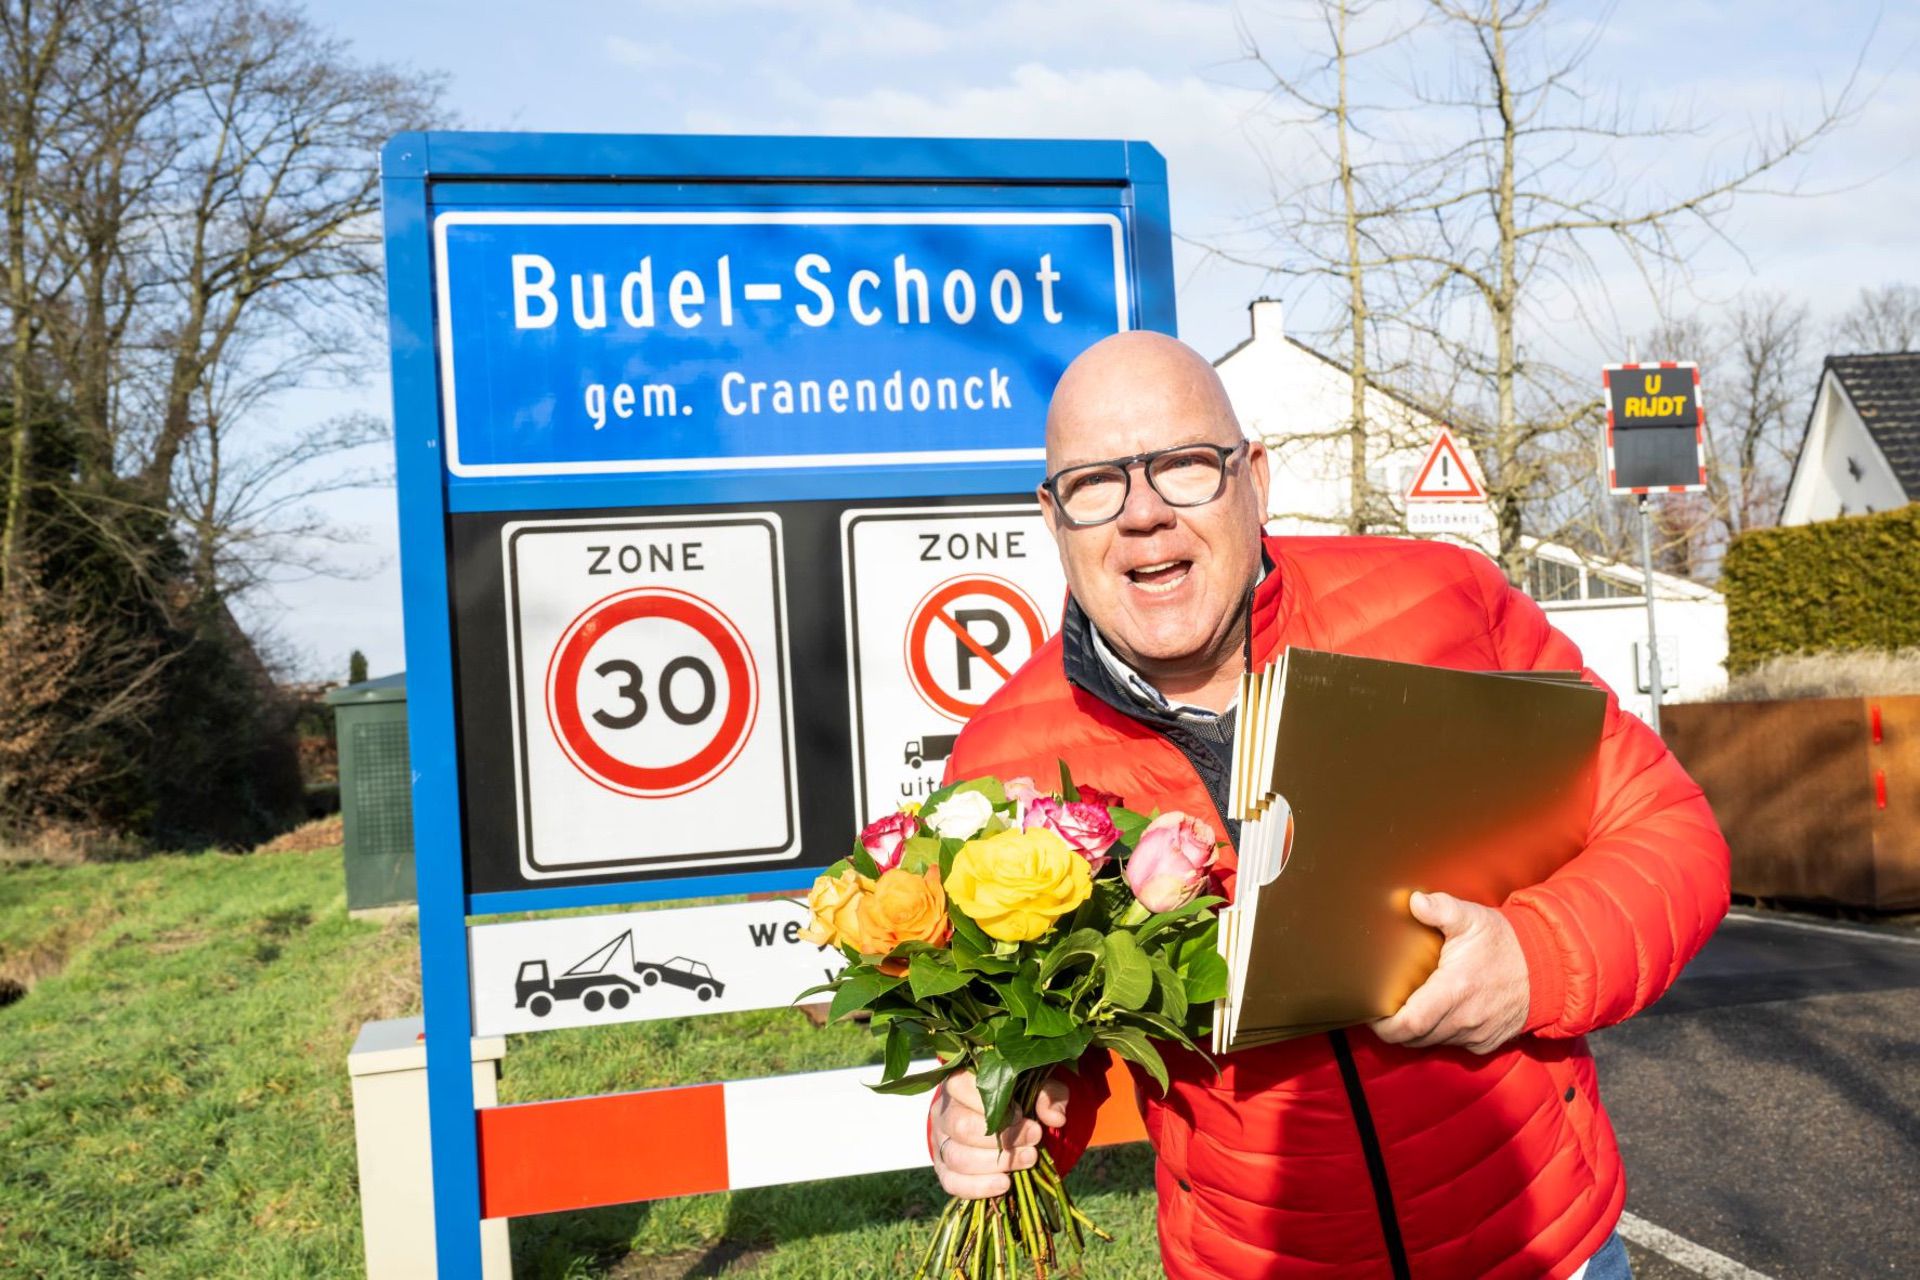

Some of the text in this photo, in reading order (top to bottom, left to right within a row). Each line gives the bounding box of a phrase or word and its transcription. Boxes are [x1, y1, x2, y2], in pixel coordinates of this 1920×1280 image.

[511, 253, 1063, 330] Budel-Schoot
[584, 367, 1012, 430] gem. Cranendonck
[1624, 395, 1687, 417] RIJDT
[1644, 374, 1662, 395] U
[586, 542, 705, 575] ZONE
[919, 531, 1027, 562] ZONE
[954, 608, 1011, 691] P
[592, 655, 716, 730] 30
